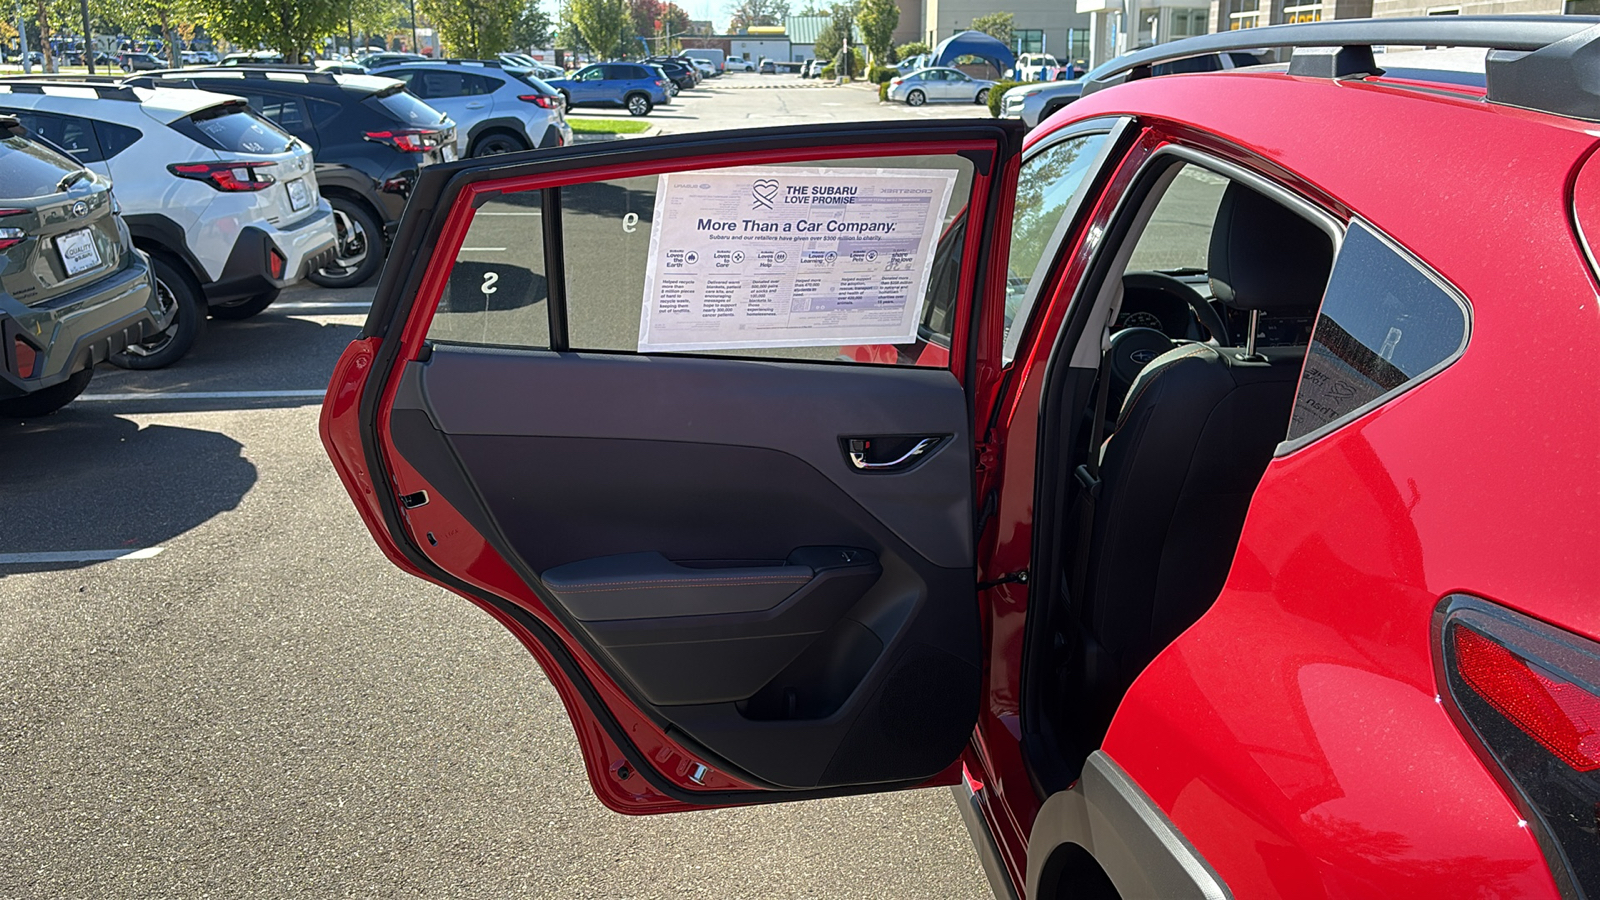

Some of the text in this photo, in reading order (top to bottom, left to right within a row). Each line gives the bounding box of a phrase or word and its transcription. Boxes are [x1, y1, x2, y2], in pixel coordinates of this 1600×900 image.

[786, 186, 857, 195] THE SUBARU
[697, 218, 896, 234] More Than a Car Company.
[70, 244, 90, 255] QUALITY
